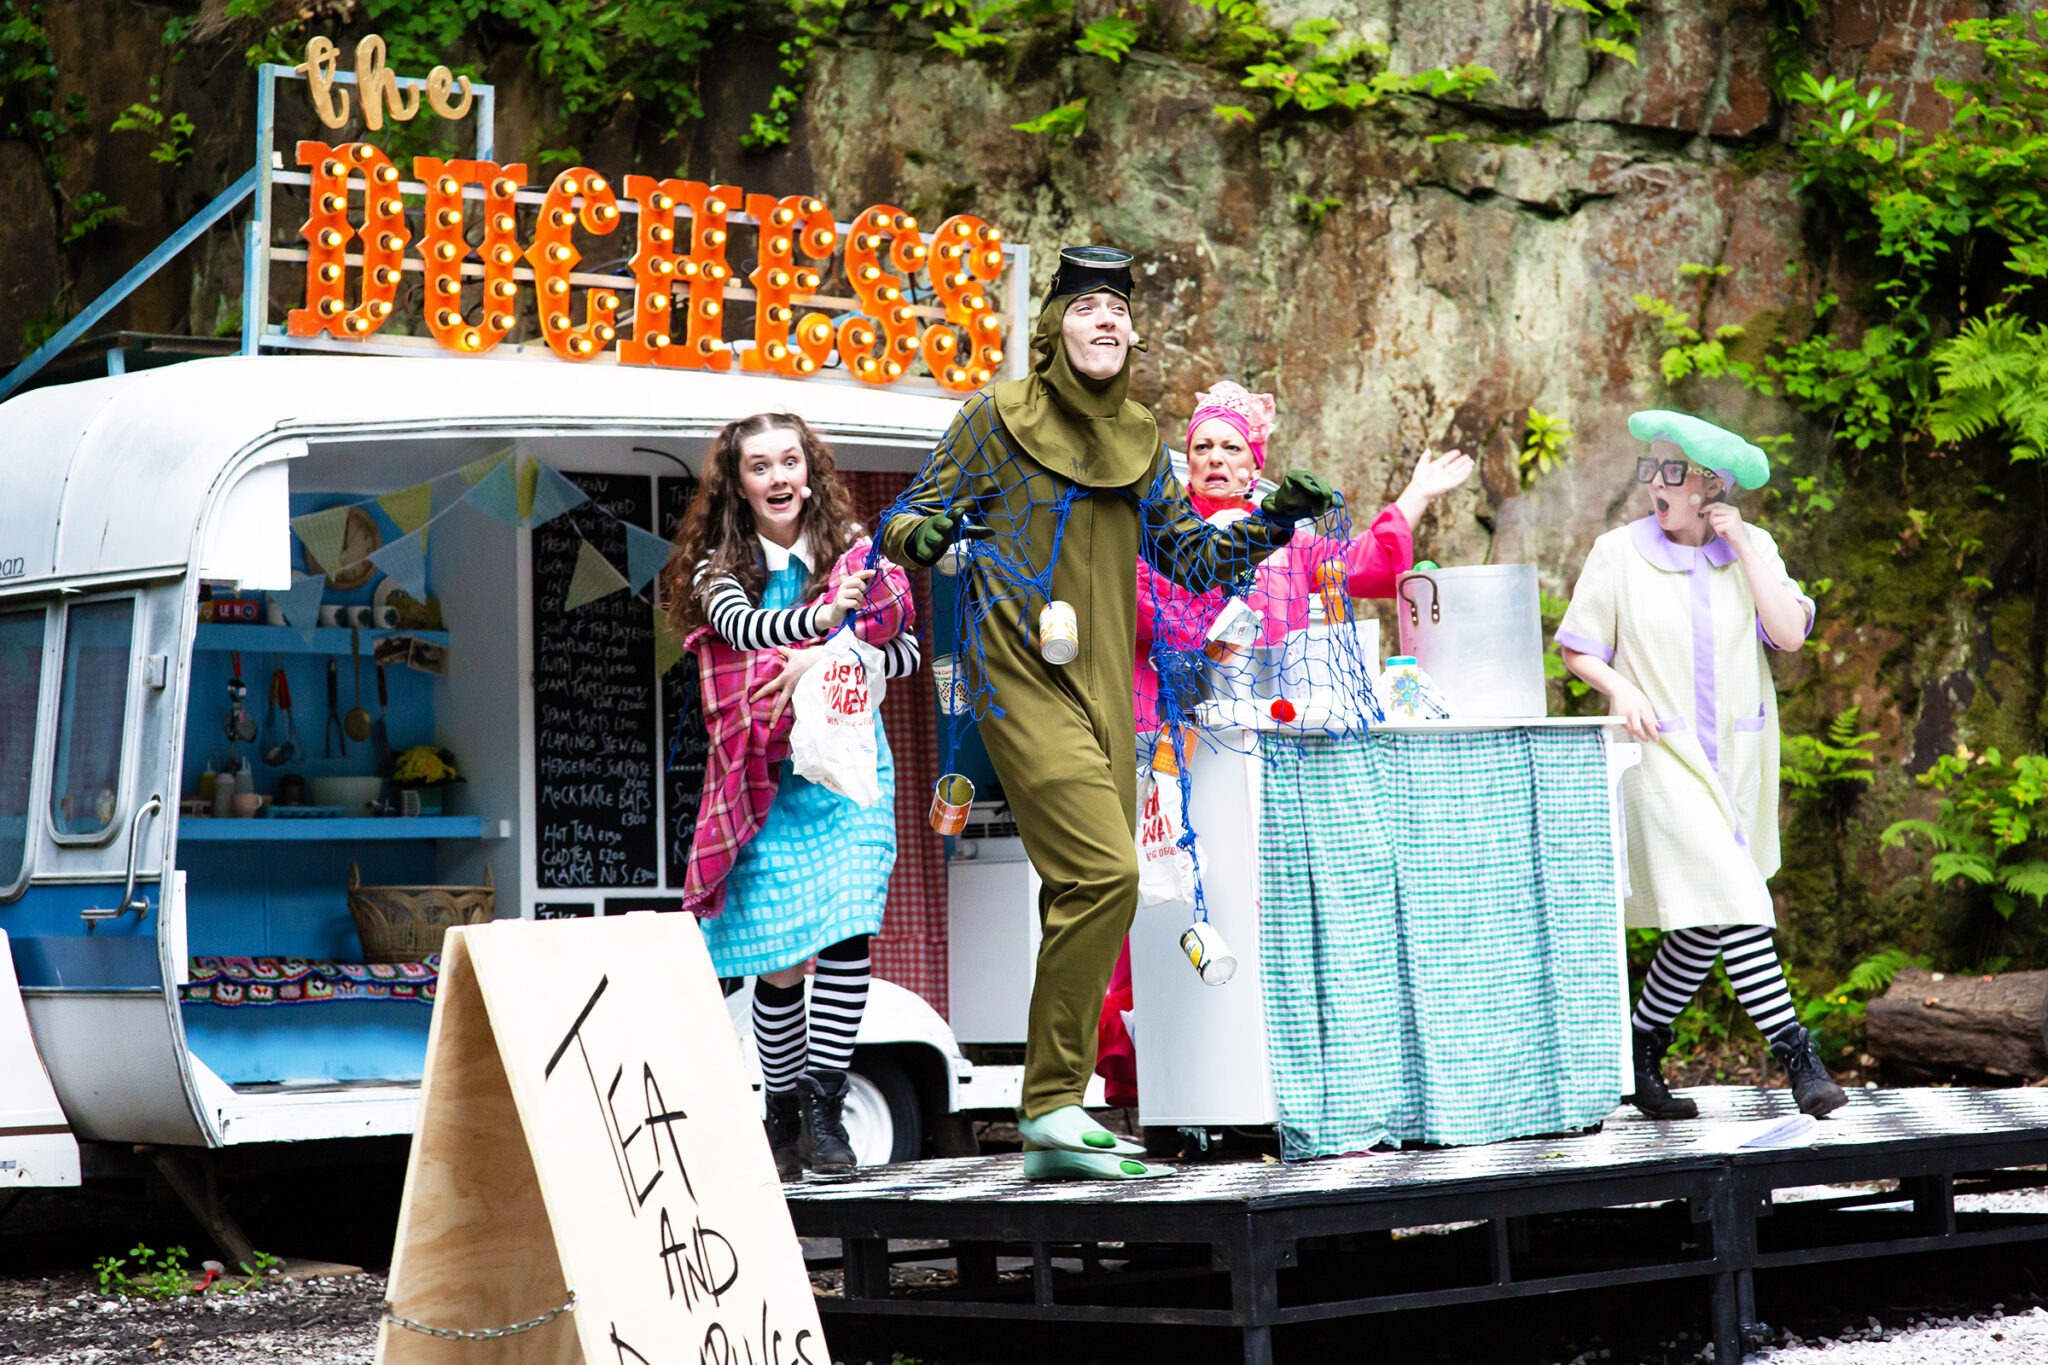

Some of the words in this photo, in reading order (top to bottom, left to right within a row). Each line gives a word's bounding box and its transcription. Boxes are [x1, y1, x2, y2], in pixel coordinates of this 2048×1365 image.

[295, 35, 472, 130] the
[288, 139, 1003, 393] DUCHESS
[539, 729, 596, 756] FLAMINGO
[595, 732, 632, 756] STEW
[540, 754, 602, 780] HEDGEHOG
[601, 758, 652, 780] SURPRISE
[541, 783, 579, 810] MOCK
[617, 787, 652, 814] BAPS
[543, 822, 570, 852] HOT
[569, 819, 595, 843] TEA
[620, 813, 649, 827] £300
[540, 847, 571, 867] COLD
[569, 845, 594, 870] TEA
[599, 848, 627, 864] £200
[545, 973, 699, 1219] TEA
[659, 1206, 739, 1313] AND
